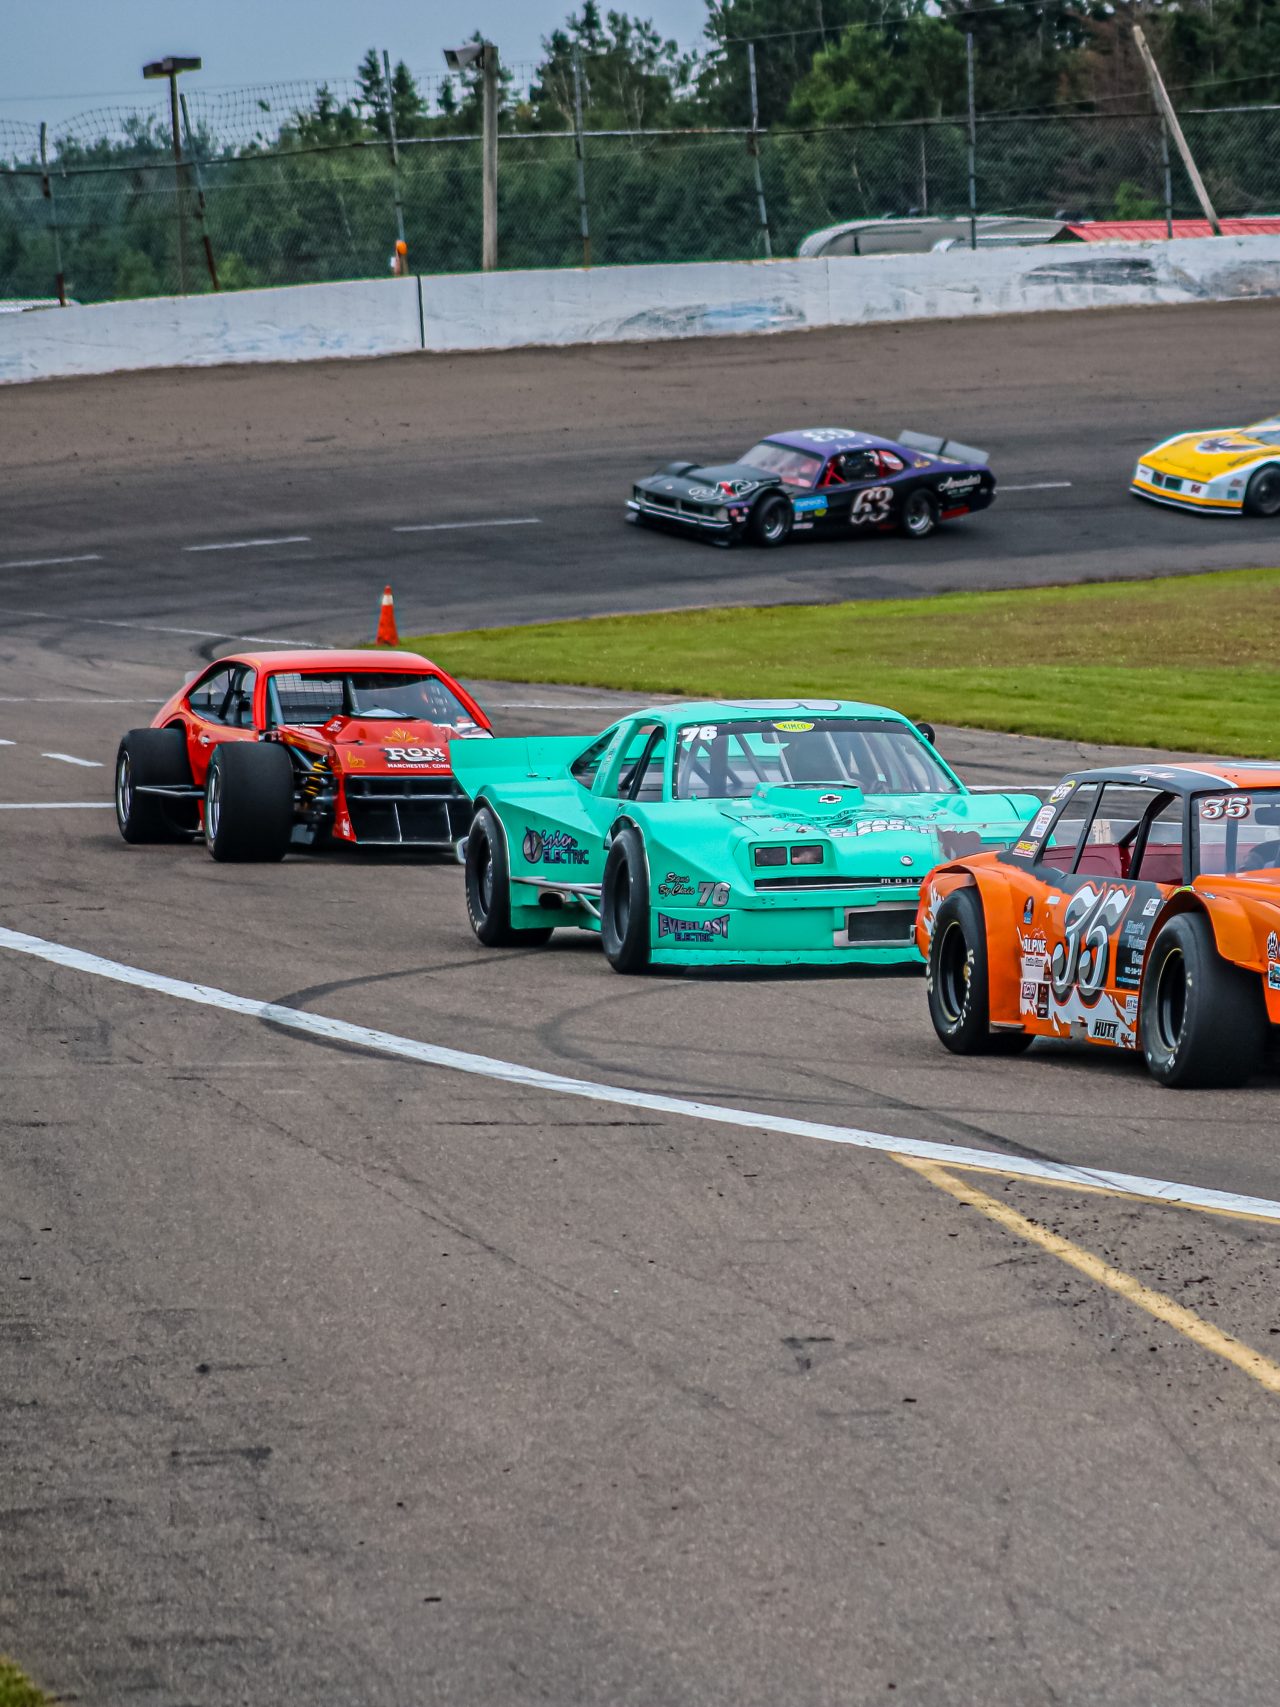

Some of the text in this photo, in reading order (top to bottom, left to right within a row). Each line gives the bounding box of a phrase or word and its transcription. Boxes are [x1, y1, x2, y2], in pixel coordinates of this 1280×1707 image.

[850, 486, 894, 524] 63
[682, 725, 718, 743] 76
[783, 722, 806, 730] KIMCO
[1201, 797, 1250, 820] 35
[543, 849, 589, 865] ELECTRIC
[697, 881, 731, 907] 76
[658, 912, 730, 939] EVERLAST
[1023, 938, 1047, 954] ALPINE
[1093, 1020, 1119, 1038] HUTT
